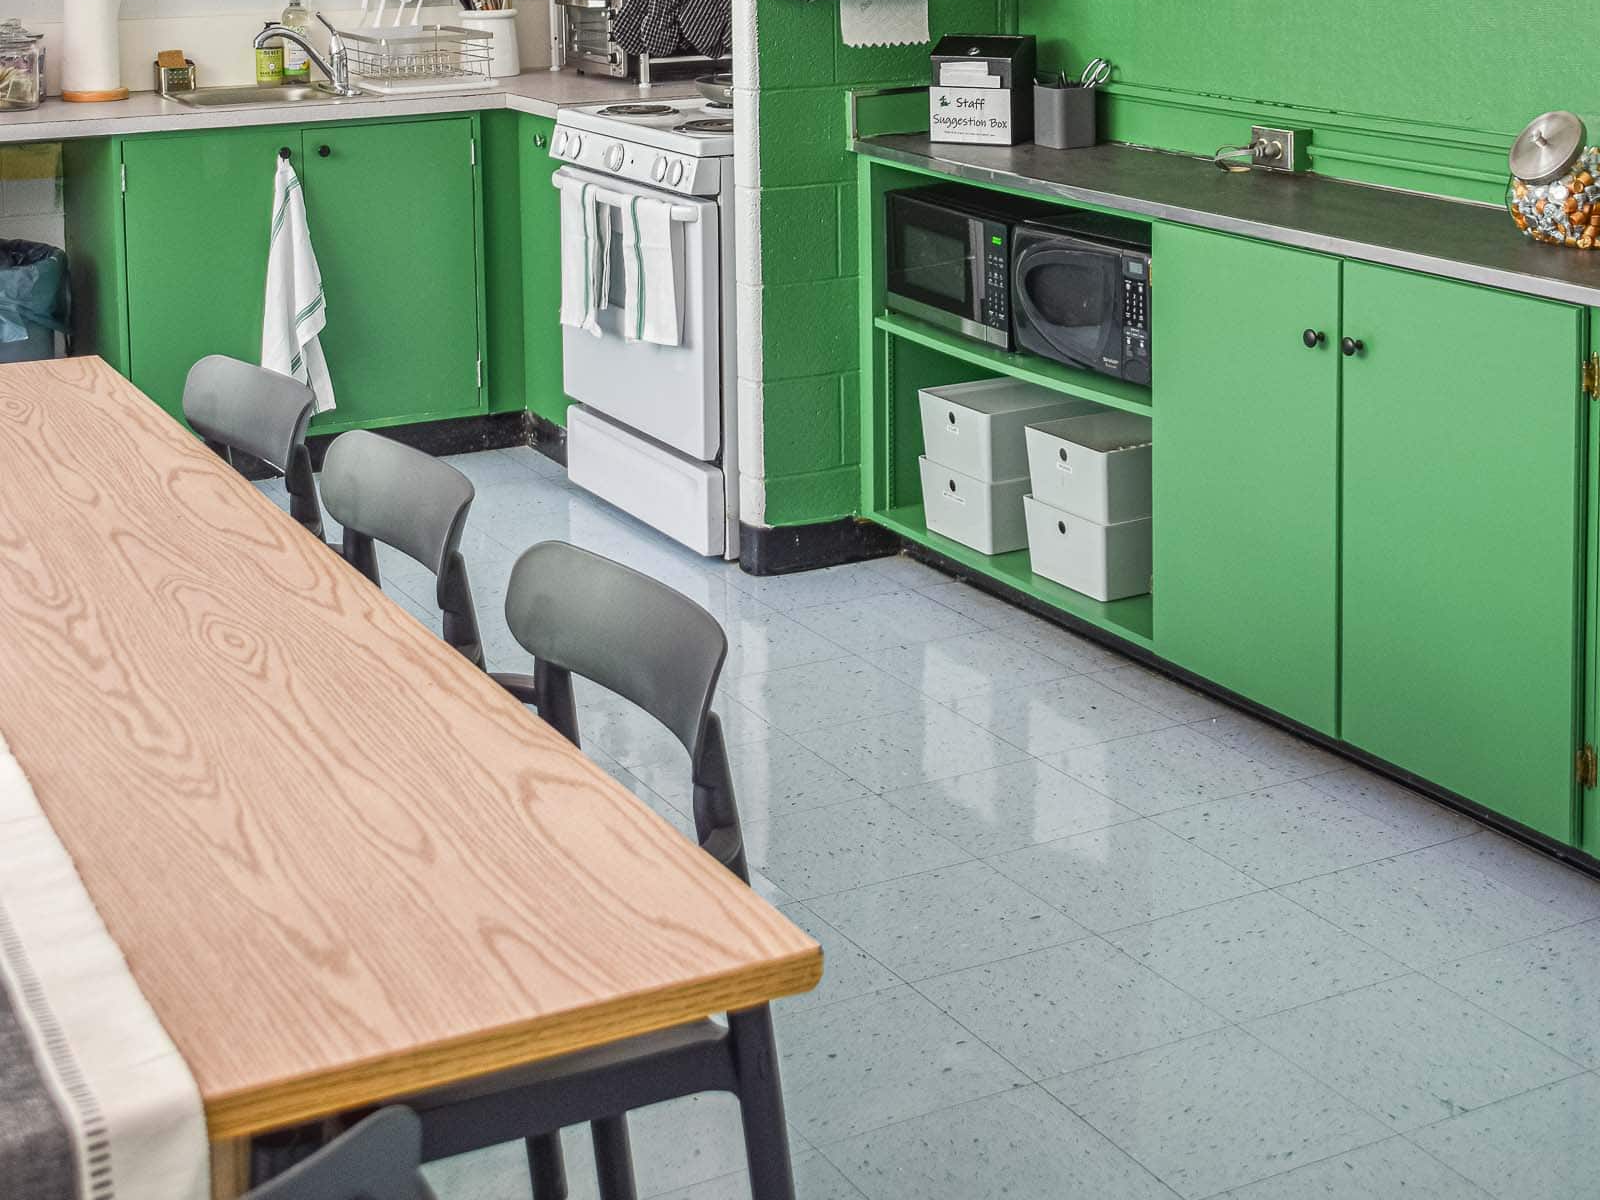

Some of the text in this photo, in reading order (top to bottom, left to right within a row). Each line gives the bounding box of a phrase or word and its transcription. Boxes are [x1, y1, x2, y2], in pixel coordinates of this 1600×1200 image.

[956, 97, 985, 111] Staff
[933, 113, 1008, 129] Suggestion Box
